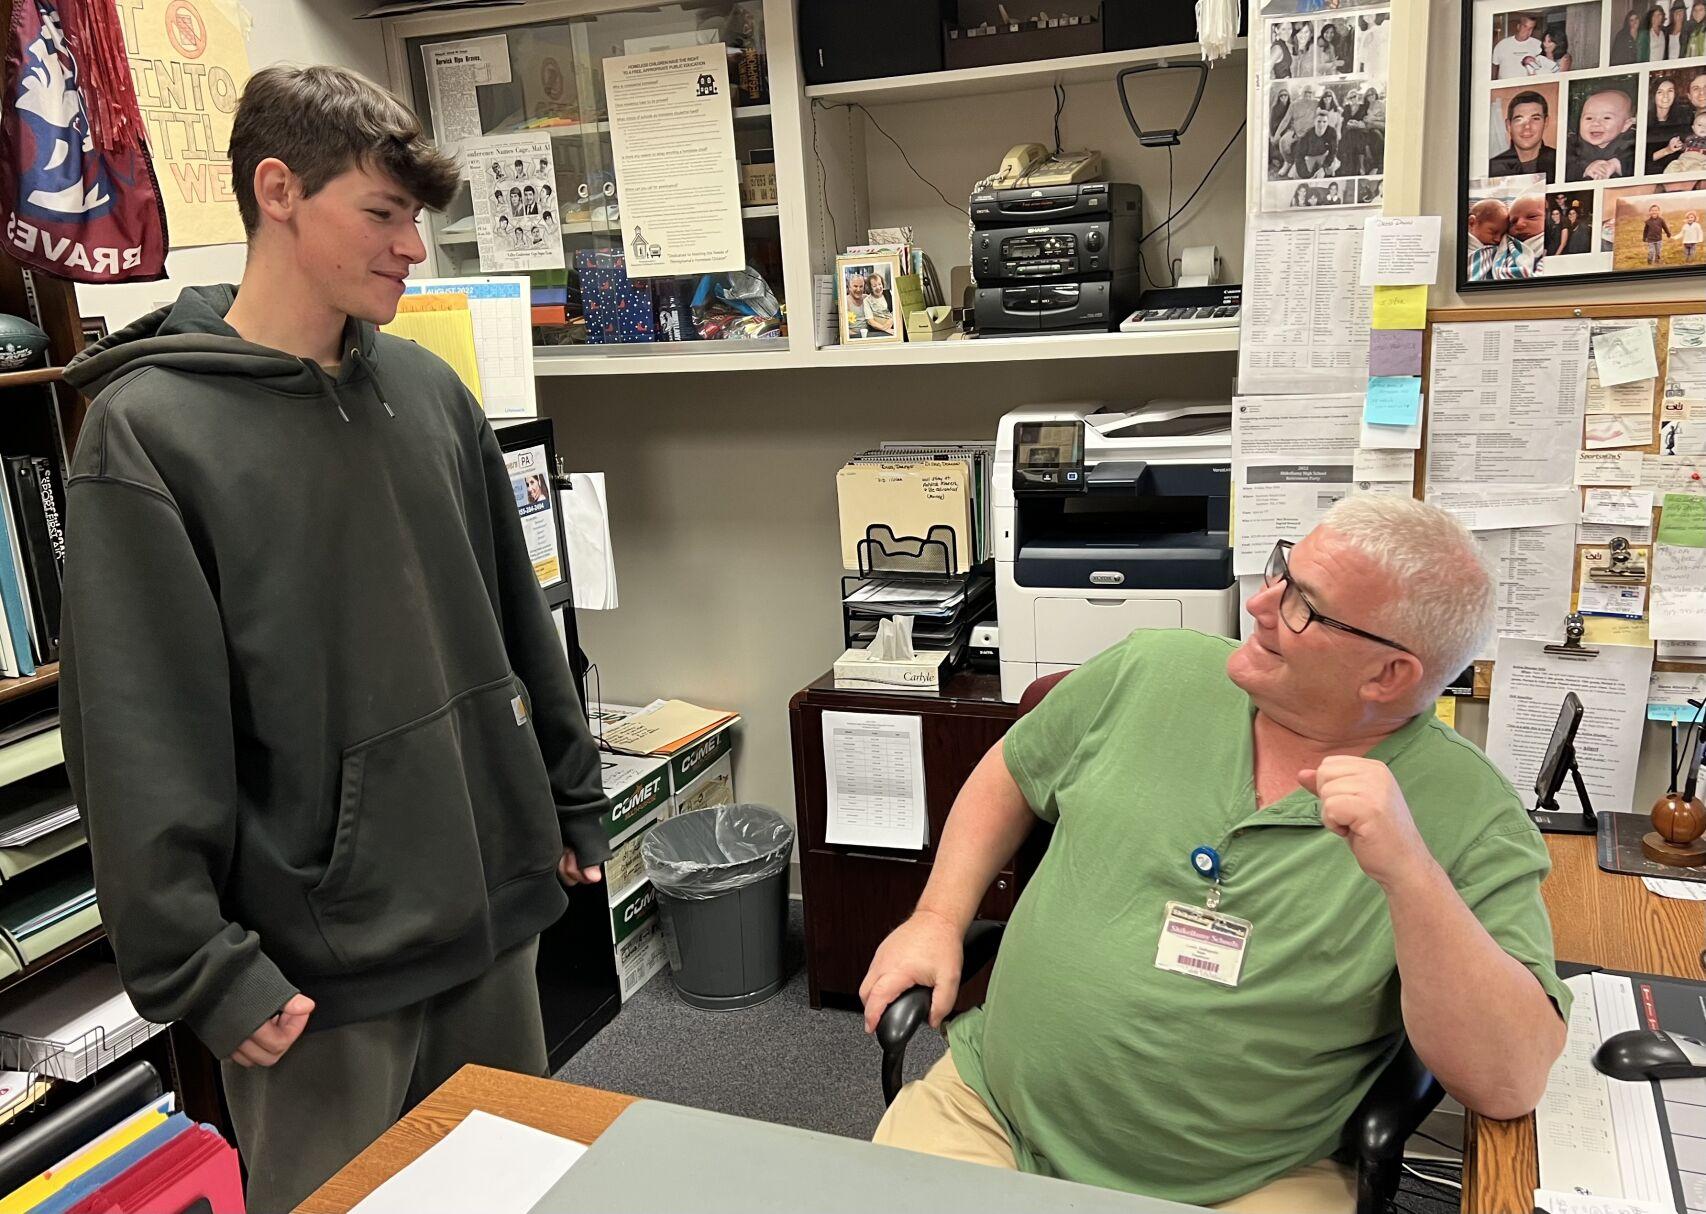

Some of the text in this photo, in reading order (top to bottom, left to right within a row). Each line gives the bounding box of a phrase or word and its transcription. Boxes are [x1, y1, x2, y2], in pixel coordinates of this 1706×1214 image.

[130, 58, 238, 114] INTO
[903, 671, 935, 683] Carlyle
[680, 734, 721, 773] COMET
[611, 777, 662, 821] COMET
[624, 887, 656, 922] COM
